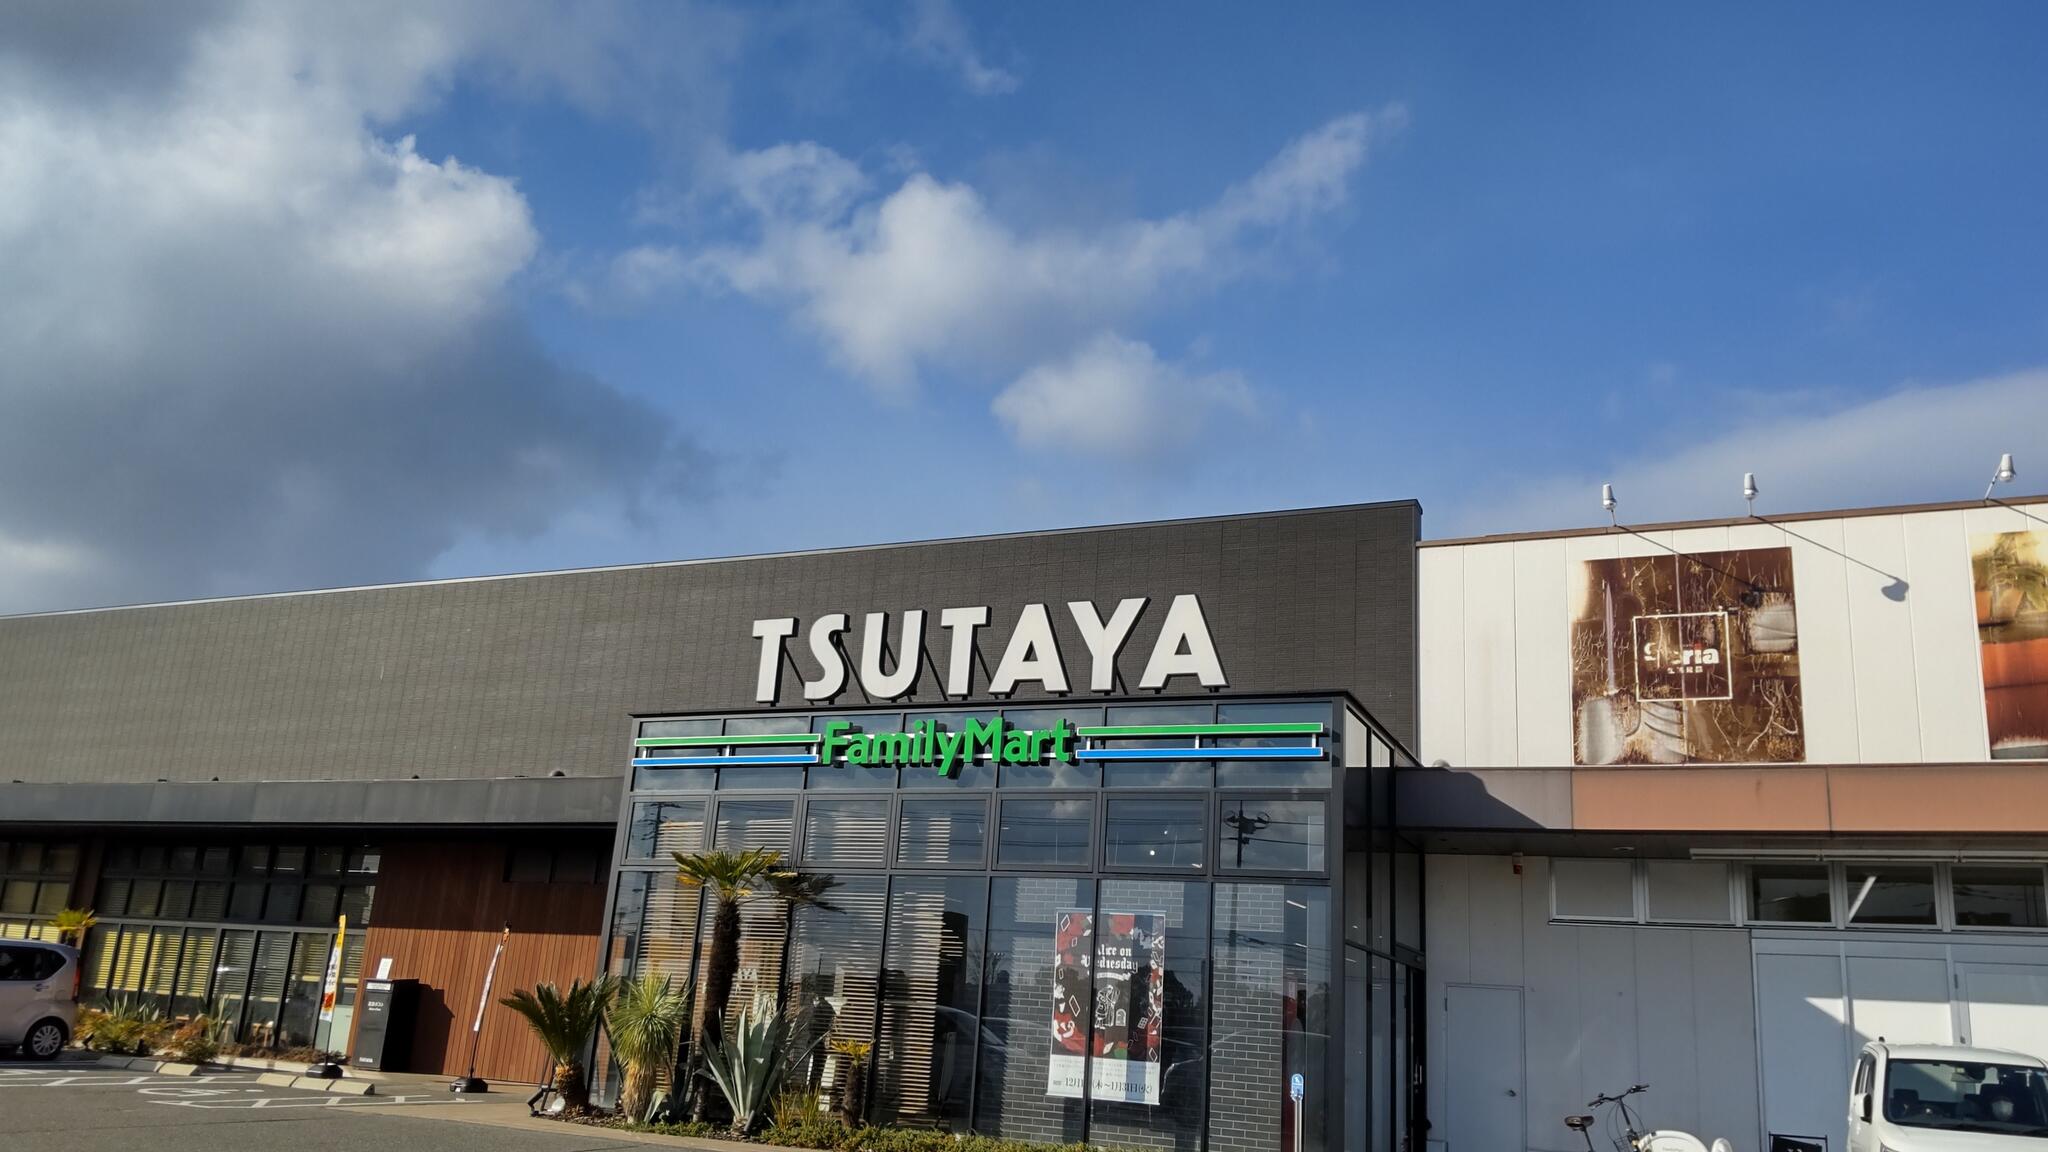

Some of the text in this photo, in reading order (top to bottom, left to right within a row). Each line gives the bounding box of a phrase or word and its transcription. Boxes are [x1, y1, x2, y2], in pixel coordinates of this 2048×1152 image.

[752, 593, 1229, 704] TSUTAYA
[1643, 641, 1720, 665] Sria
[821, 717, 1072, 776] FamilyMart
[1120, 947, 1132, 957] on
